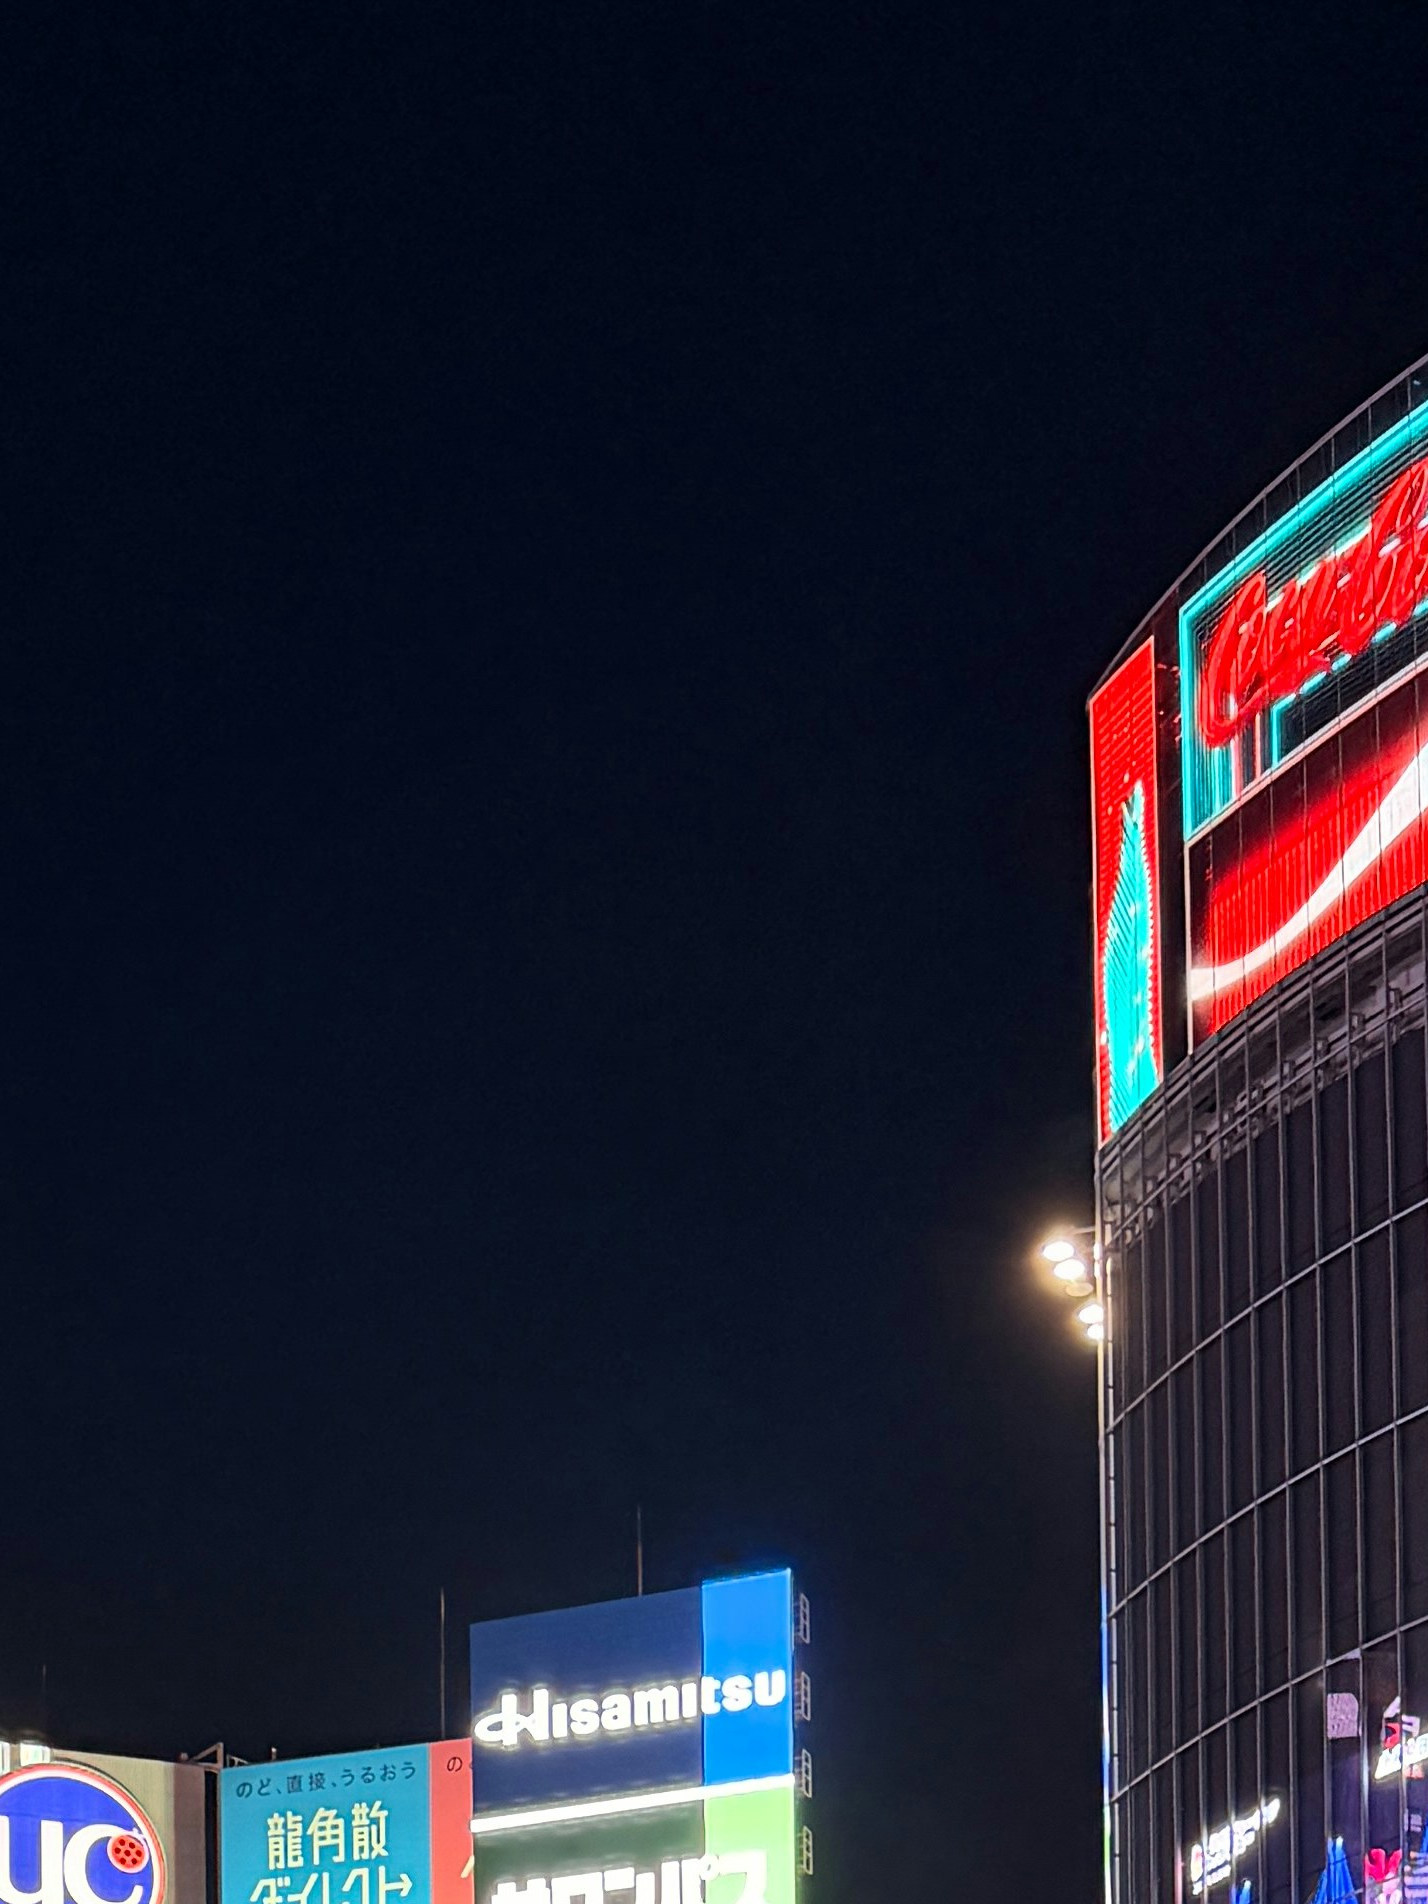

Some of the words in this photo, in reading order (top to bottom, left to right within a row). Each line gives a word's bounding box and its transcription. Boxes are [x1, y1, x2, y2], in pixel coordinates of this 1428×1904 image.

[474, 1668, 787, 1749] Hisamitsu
[235, 1760, 417, 1799] のど、直接、うるおう
[266, 1800, 389, 1870] 龍角散
